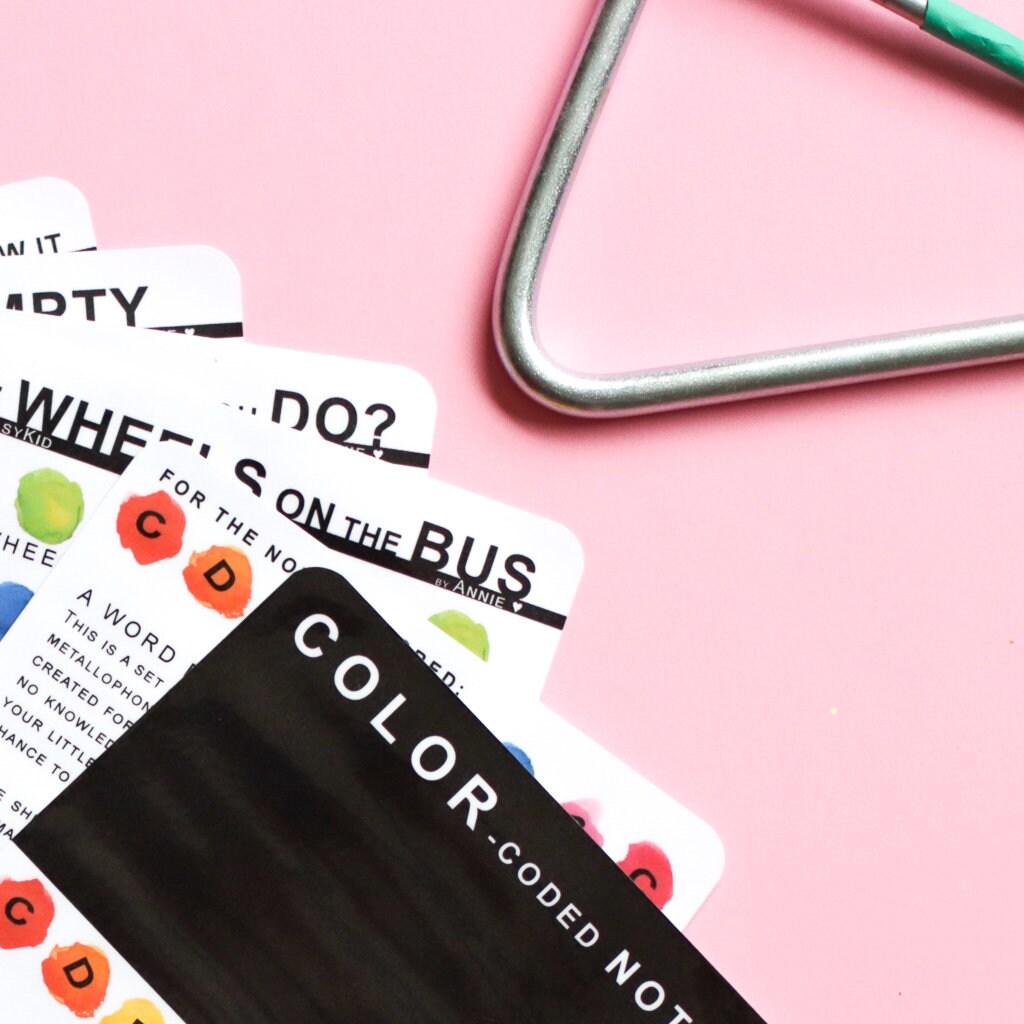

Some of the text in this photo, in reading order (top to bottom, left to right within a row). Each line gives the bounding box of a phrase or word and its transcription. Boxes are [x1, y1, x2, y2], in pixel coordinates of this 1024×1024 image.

[36, 233, 61, 254] IT
[159, 468, 206, 509] FOR
[215, 506, 259, 546] THE
[276, 488, 337, 533] ON
[344, 515, 403, 558] THE
[409, 520, 537, 602] BUS
[135, 510, 167, 539] C
[203, 558, 236, 592] D
[76, 588, 177, 664] A WORD
[434, 577, 505, 610] BY ANNIE
[16, 675, 39, 697] NO
[32, 655, 99, 707] CREATED
[63, 608, 99, 643] THIS
[101, 639, 118, 656] IS
[119, 654, 131, 668] A
[133, 663, 165, 689] SET
[2, 696, 44, 732] YOUR
[52, 763, 71, 784] TO
[293, 612, 601, 950] COLOR-CODED
[4, 896, 35, 926] C
[63, 957, 95, 990] D
